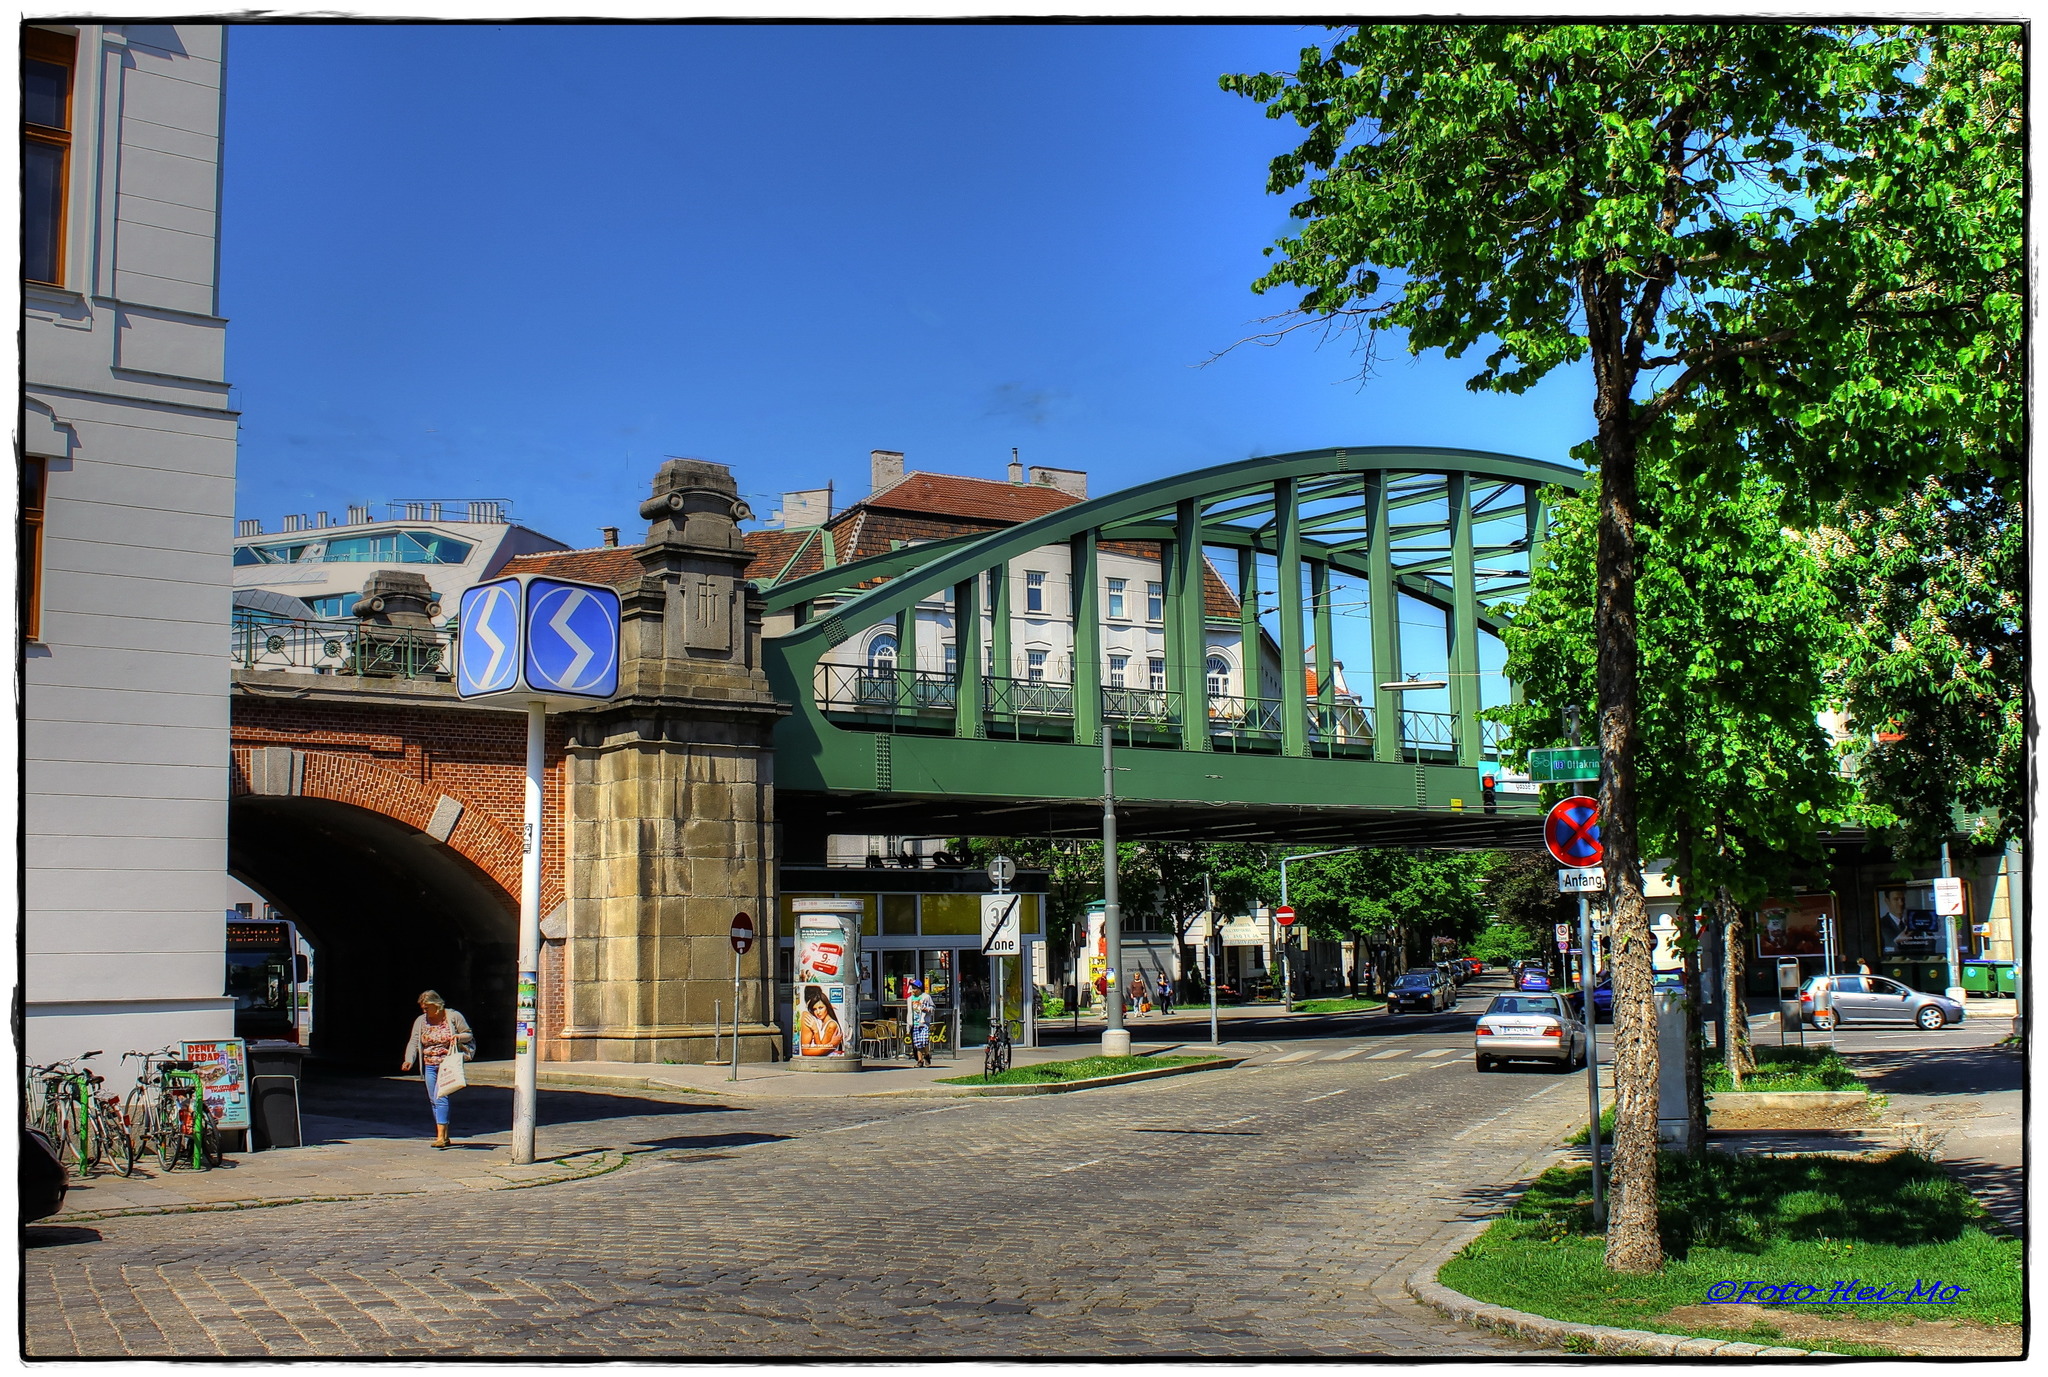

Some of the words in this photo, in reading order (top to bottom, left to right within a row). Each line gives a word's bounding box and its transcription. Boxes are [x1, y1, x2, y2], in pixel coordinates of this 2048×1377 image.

[1567, 759, 1600, 770] Ottakrin
[1564, 873, 1602, 889] Anfang
[990, 906, 1010, 928] 30
[987, 937, 1015, 951] Zone
[187, 1043, 217, 1053] DENIZ
